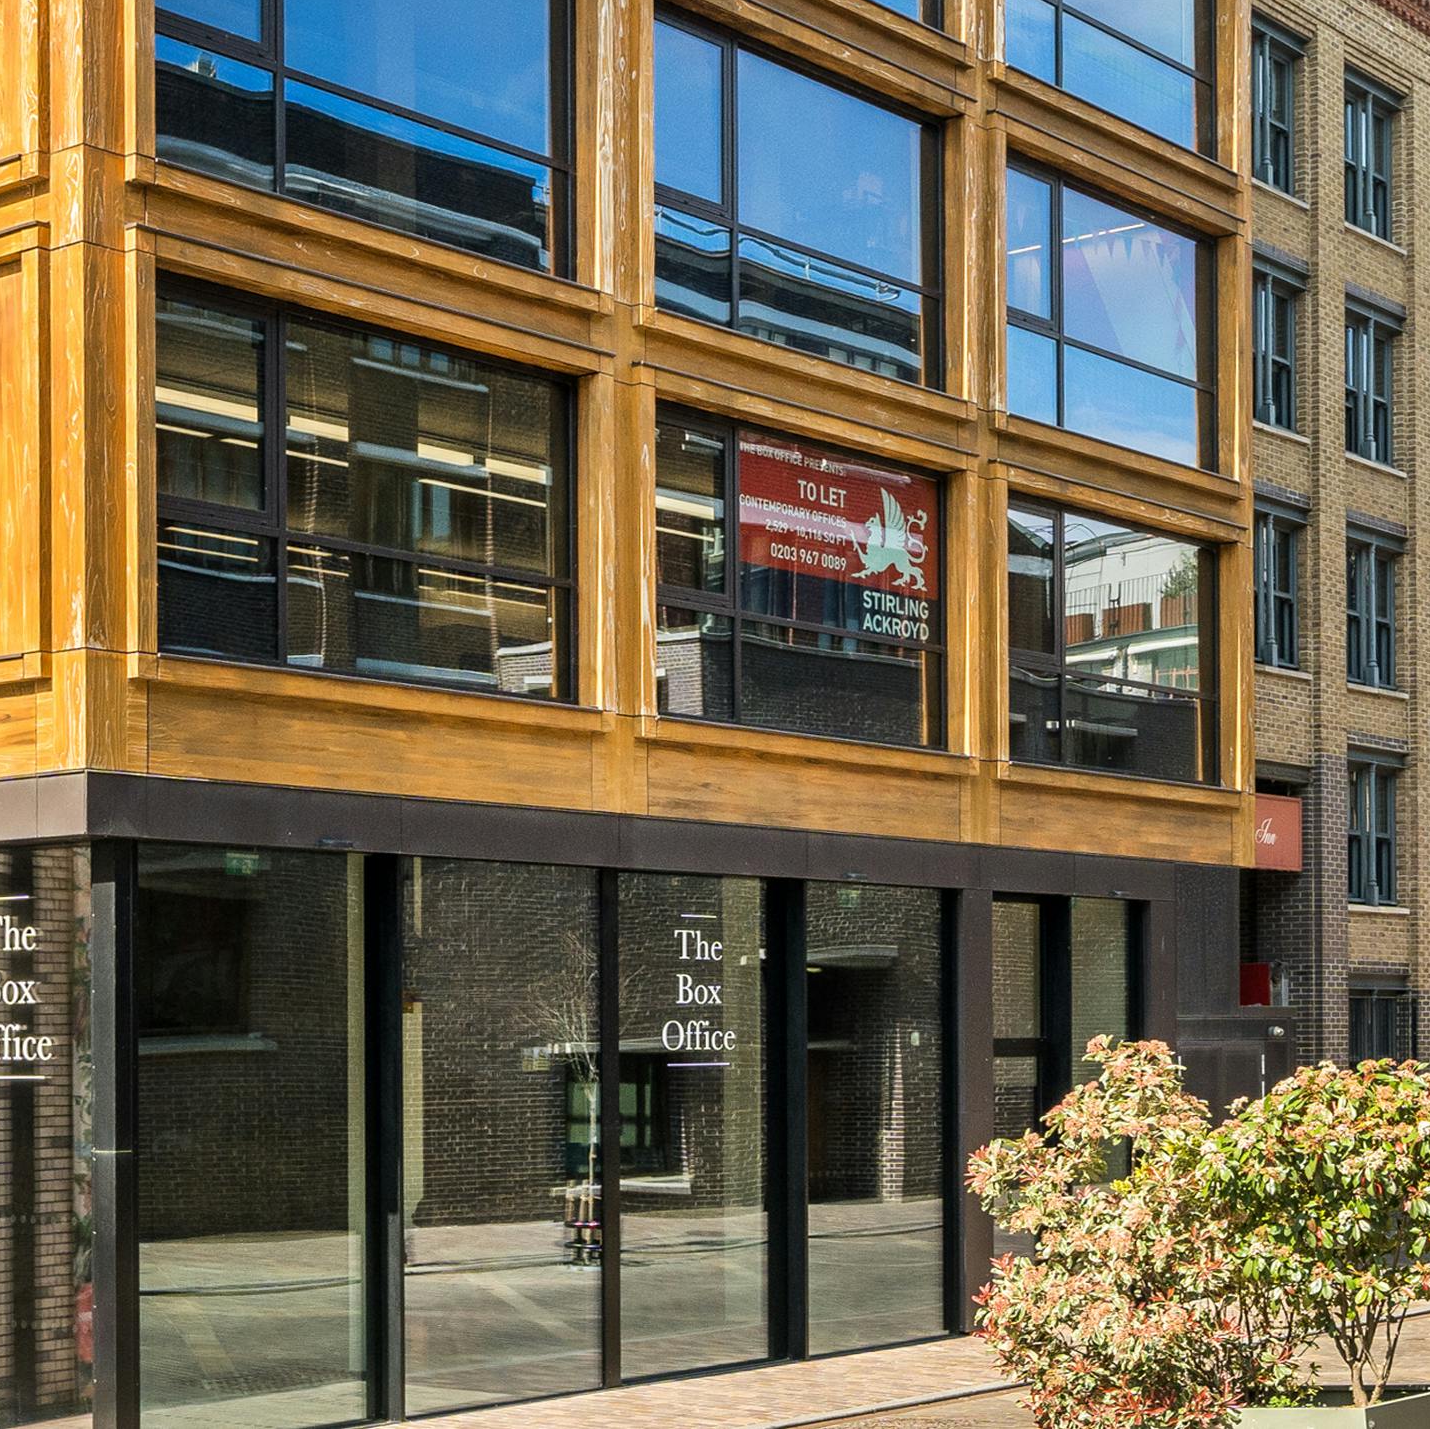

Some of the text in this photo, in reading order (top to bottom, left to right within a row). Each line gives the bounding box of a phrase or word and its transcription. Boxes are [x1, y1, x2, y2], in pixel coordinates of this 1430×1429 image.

[739, 441, 757, 455] THE
[757, 445, 774, 459] BOX
[774, 449, 803, 467] OFFICE
[797, 478, 847, 509] TO LET
[739, 493, 848, 529] CONTEMPORARY OFFICES
[823, 530, 836, 544] SQ
[836, 534, 847, 547] FT
[770, 542, 847, 572] 0203 967 0089
[862, 590, 930, 620] STIRLING
[862, 612, 930, 641] ACKROYD
[1255, 817, 1277, 846] Inn
[674, 929, 723, 961] The
[676, 973, 722, 1005] Box
[662, 1020, 736, 1051] Office
